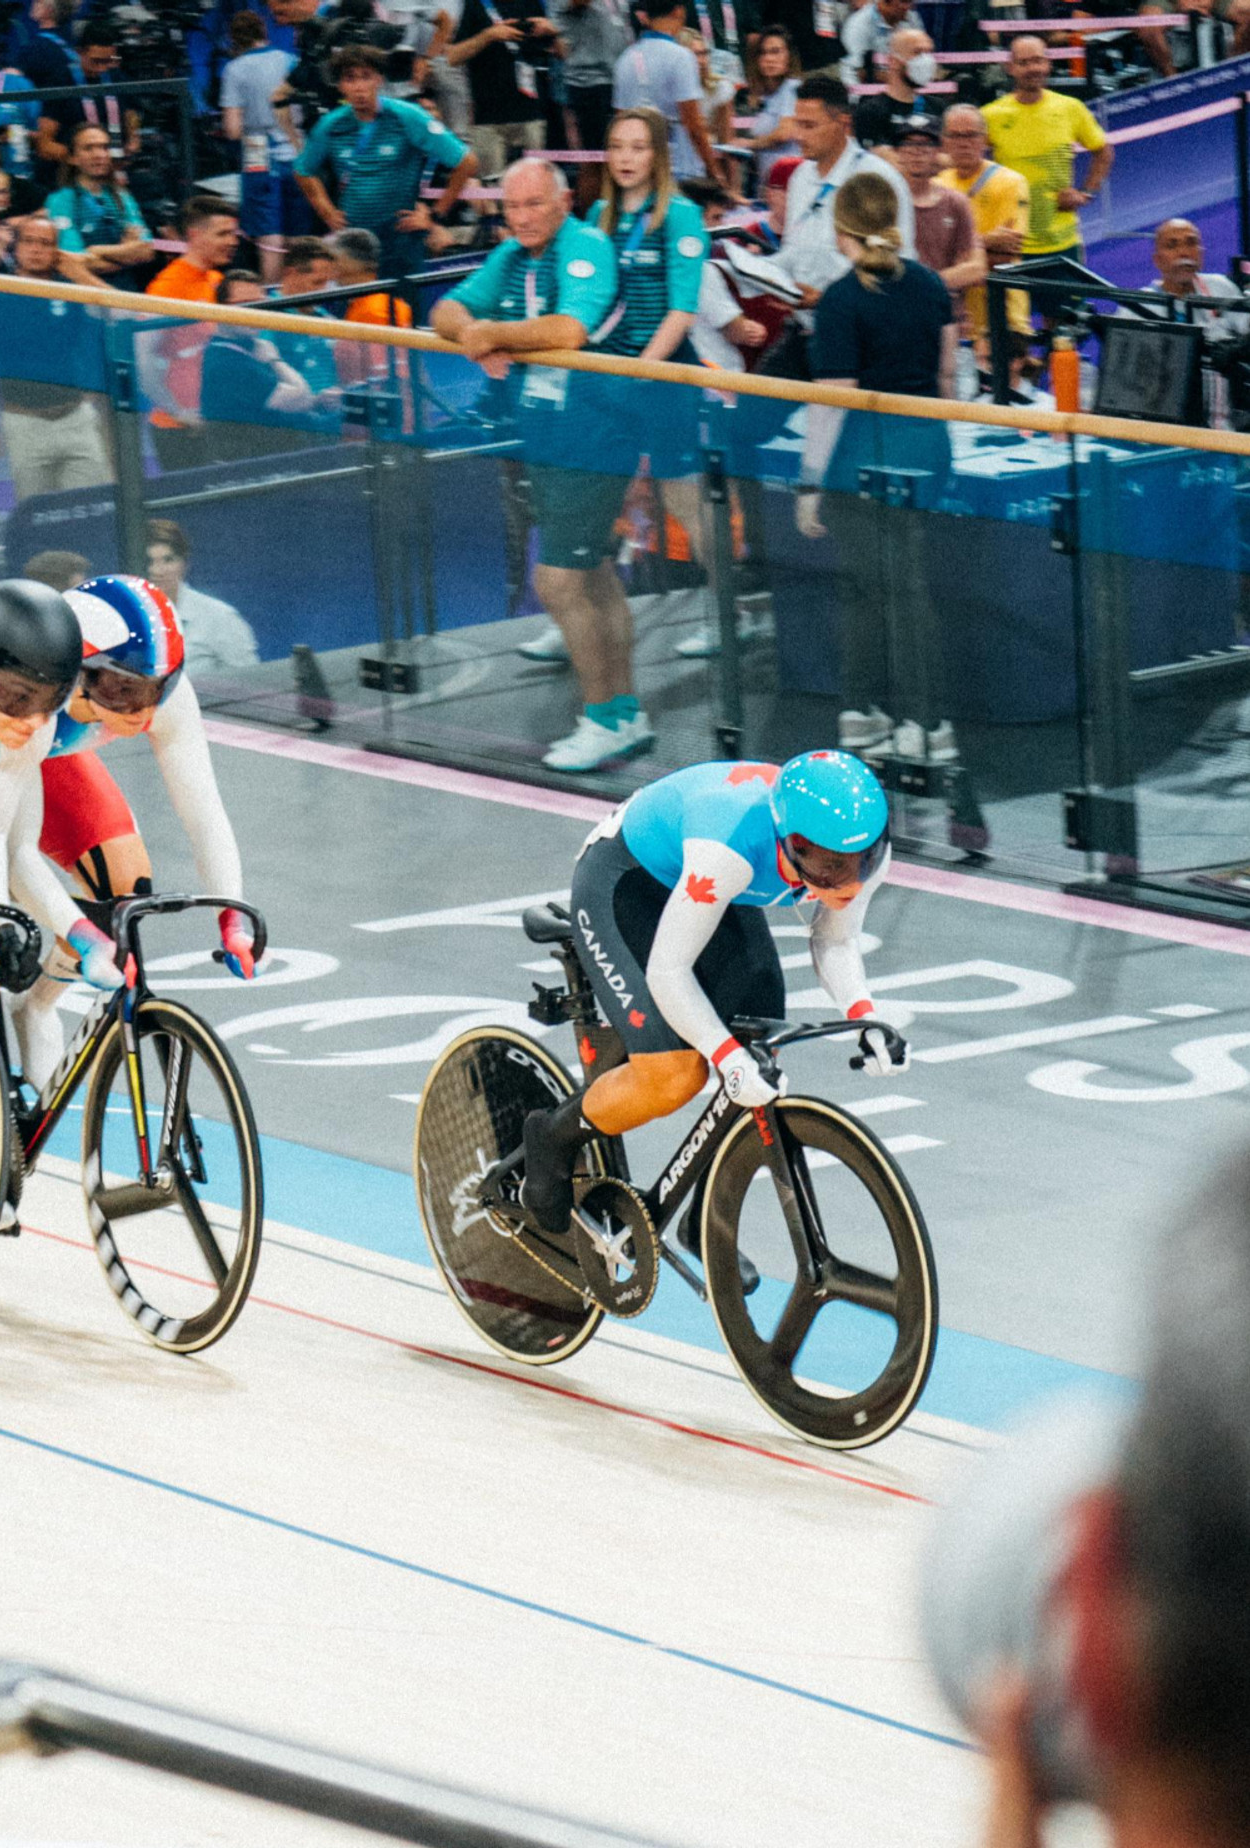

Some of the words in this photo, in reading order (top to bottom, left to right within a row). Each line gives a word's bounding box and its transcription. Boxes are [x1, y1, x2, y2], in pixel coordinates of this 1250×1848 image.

[576, 908, 634, 1010] CANADA
[40, 988, 112, 1111] LOOK
[658, 1109, 717, 1205] ARGON
